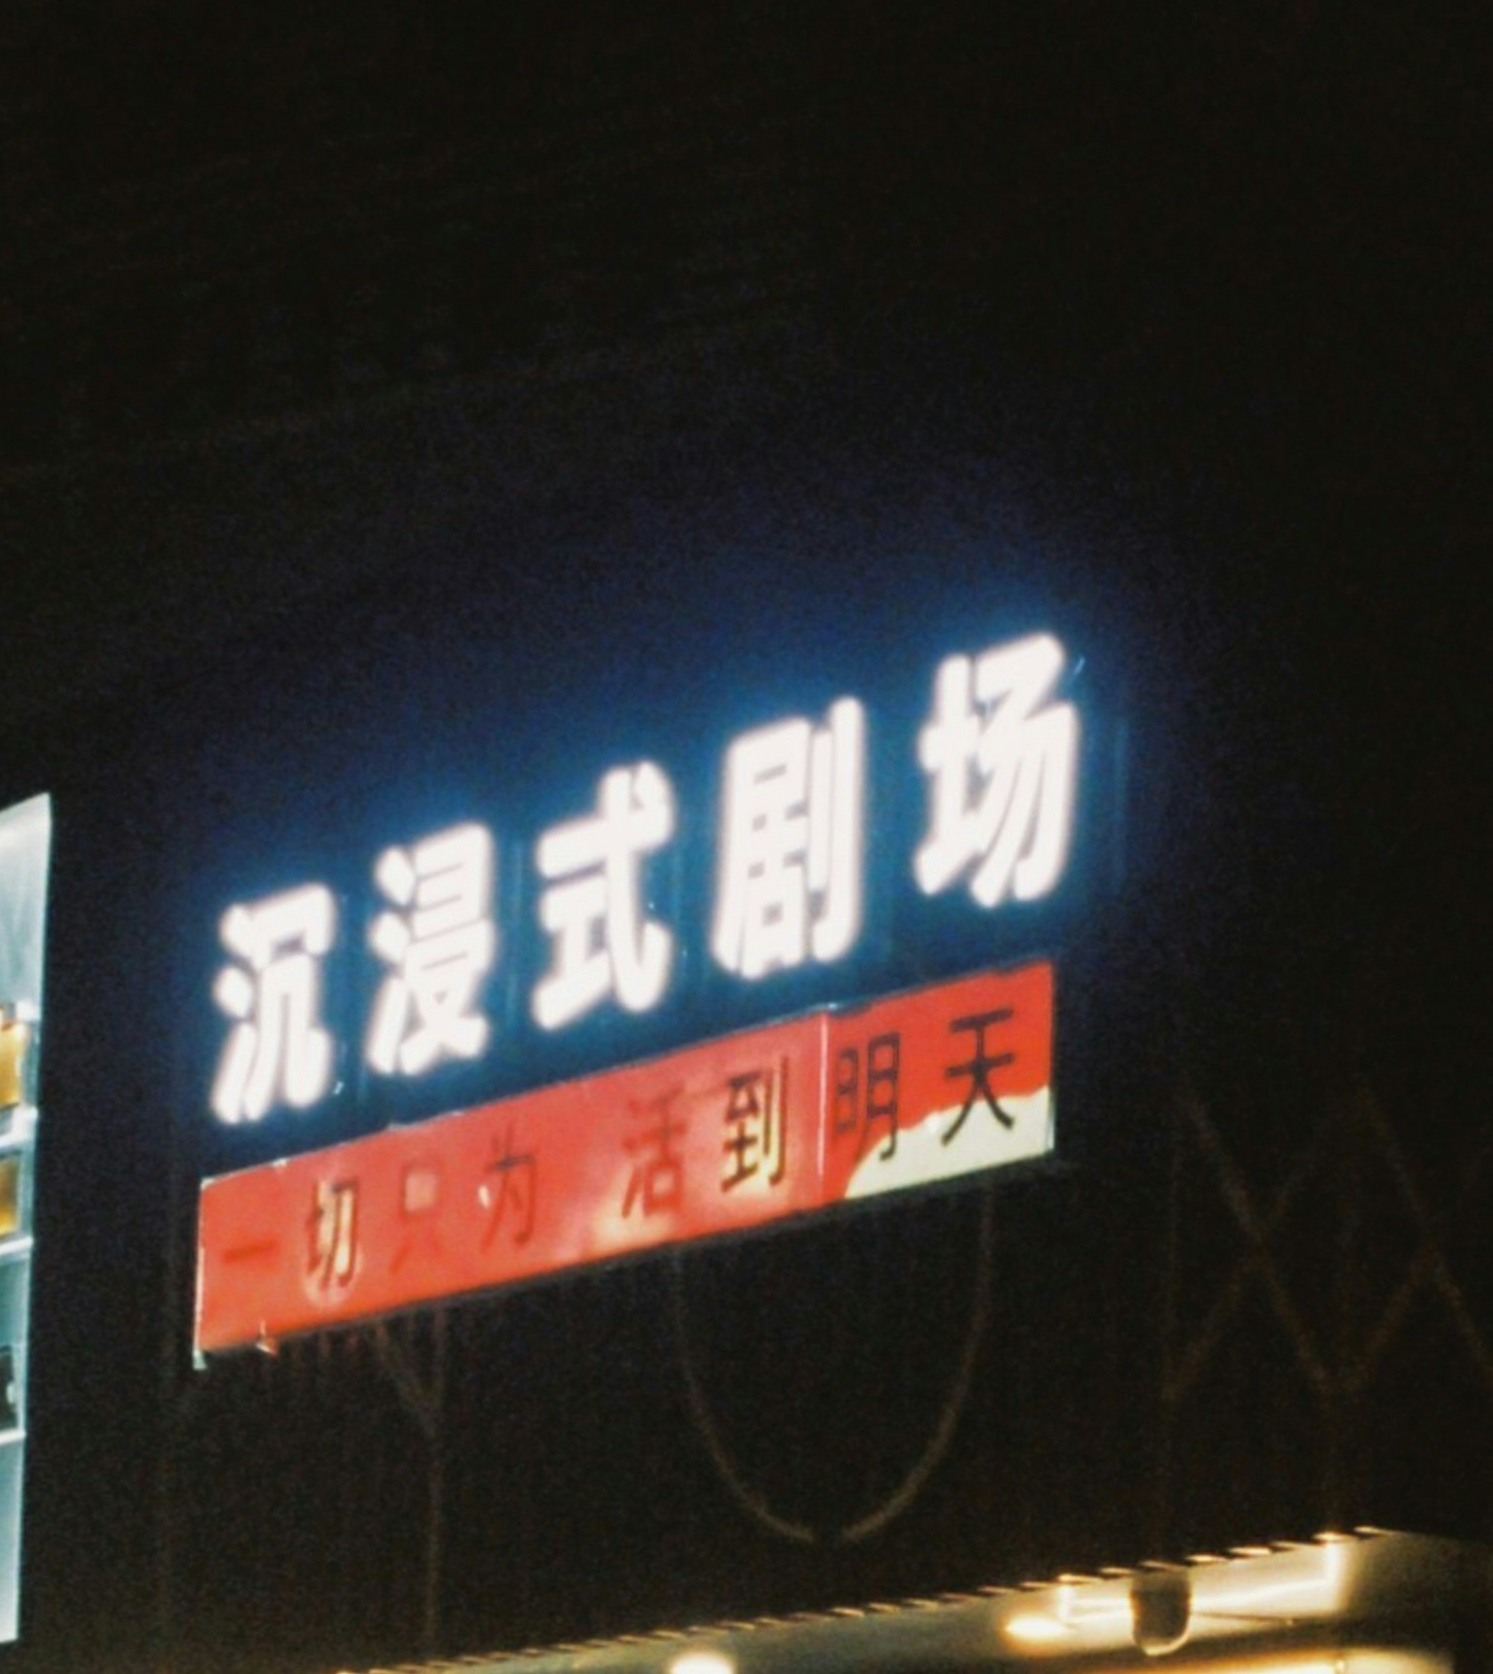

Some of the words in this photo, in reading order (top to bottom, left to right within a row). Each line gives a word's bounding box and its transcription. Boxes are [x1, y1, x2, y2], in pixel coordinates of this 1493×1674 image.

[211, 633, 1080, 1125] 沉浸式剧场
